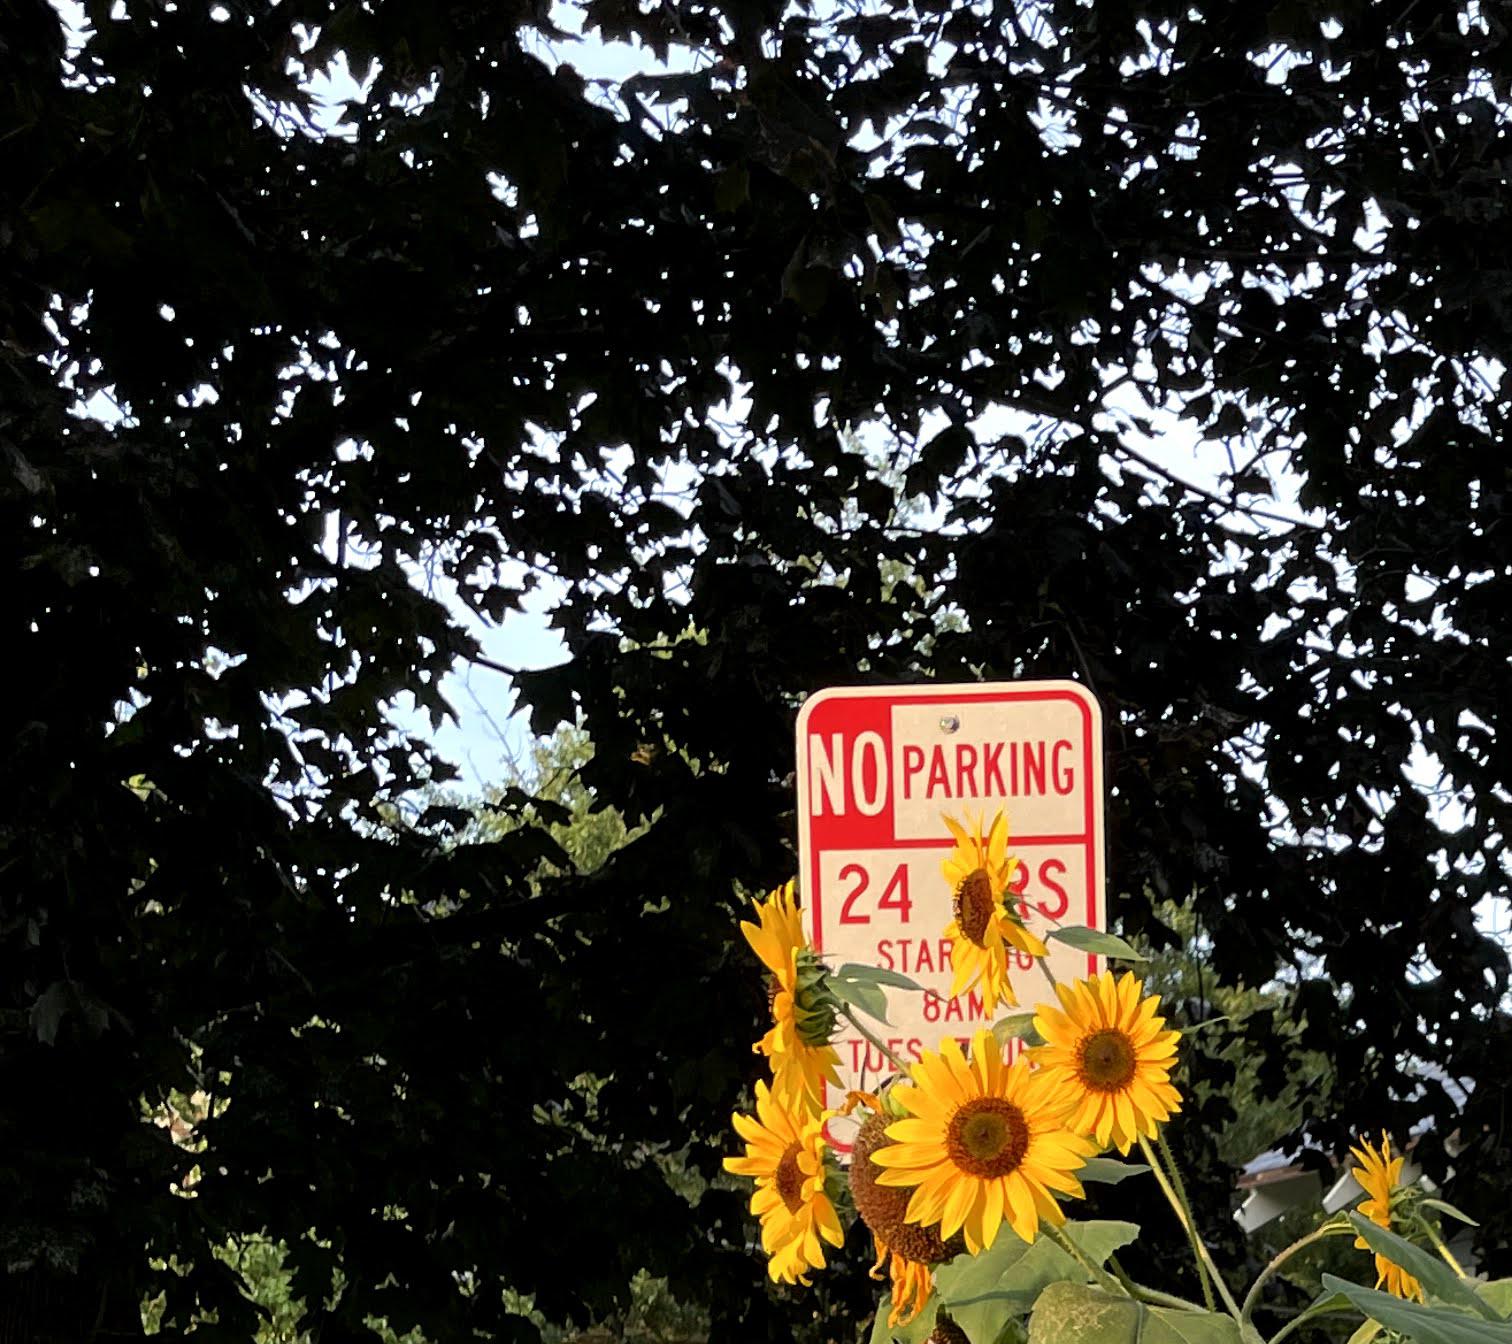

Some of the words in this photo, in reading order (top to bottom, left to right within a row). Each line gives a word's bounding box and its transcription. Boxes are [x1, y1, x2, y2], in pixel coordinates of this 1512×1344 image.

[809, 730, 888, 817] NO
[903, 739, 1075, 800] PARKING
[838, 863, 912, 925] 24
[1004, 858, 1068, 921] RS
[876, 938, 1034, 973] STARG
